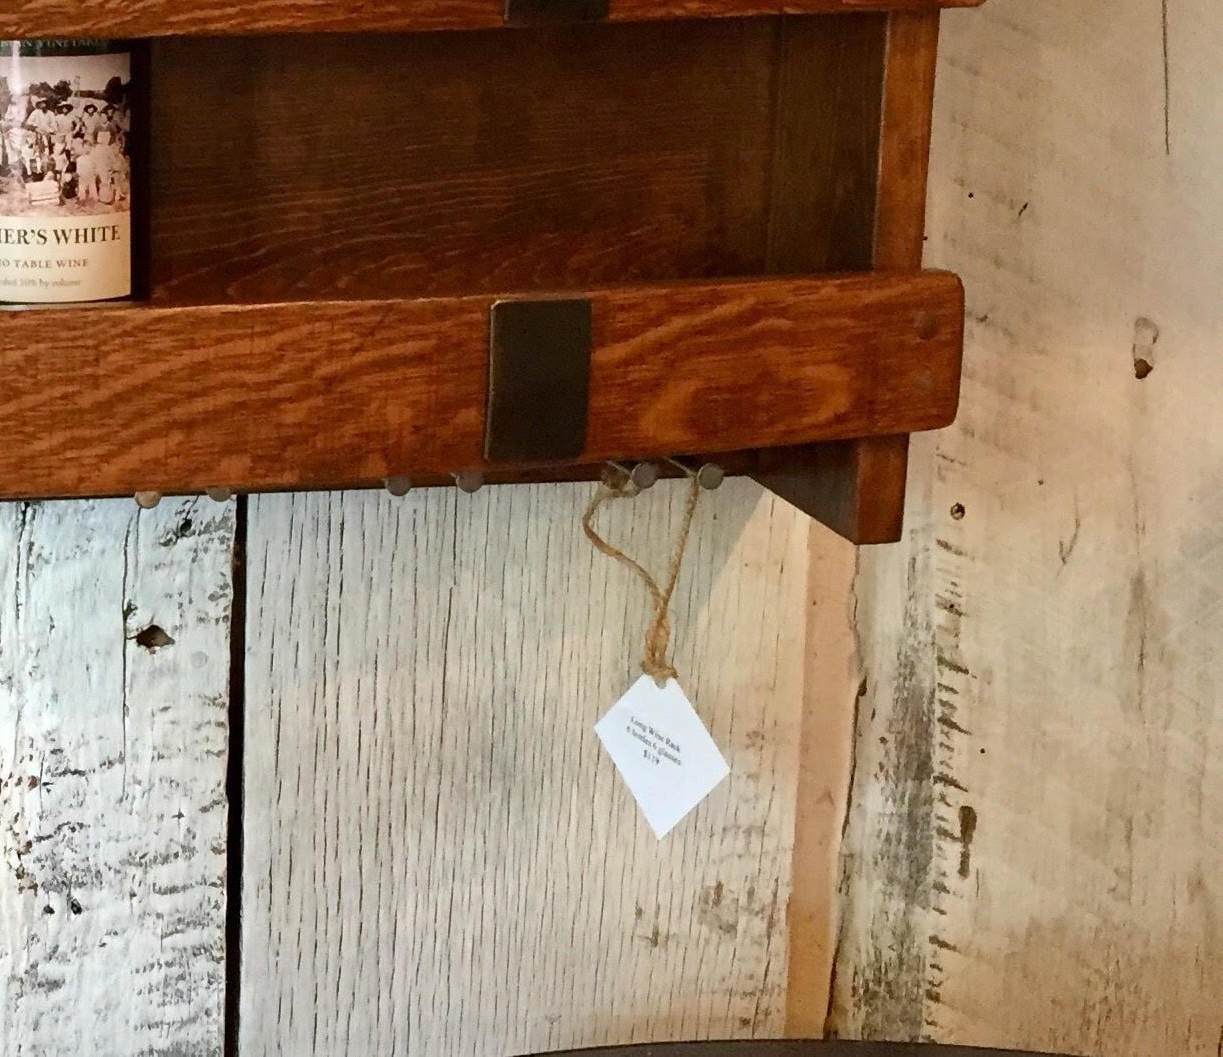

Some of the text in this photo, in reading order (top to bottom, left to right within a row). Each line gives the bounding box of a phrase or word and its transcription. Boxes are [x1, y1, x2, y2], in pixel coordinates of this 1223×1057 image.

[52, 224, 121, 245] WHITE
[14, 259, 52, 269] TABLE
[56, 258, 89, 268] WINE
[39, 278, 50, 289] by
[648, 726, 664, 742] Wine
[665, 737, 681, 752] Rack
